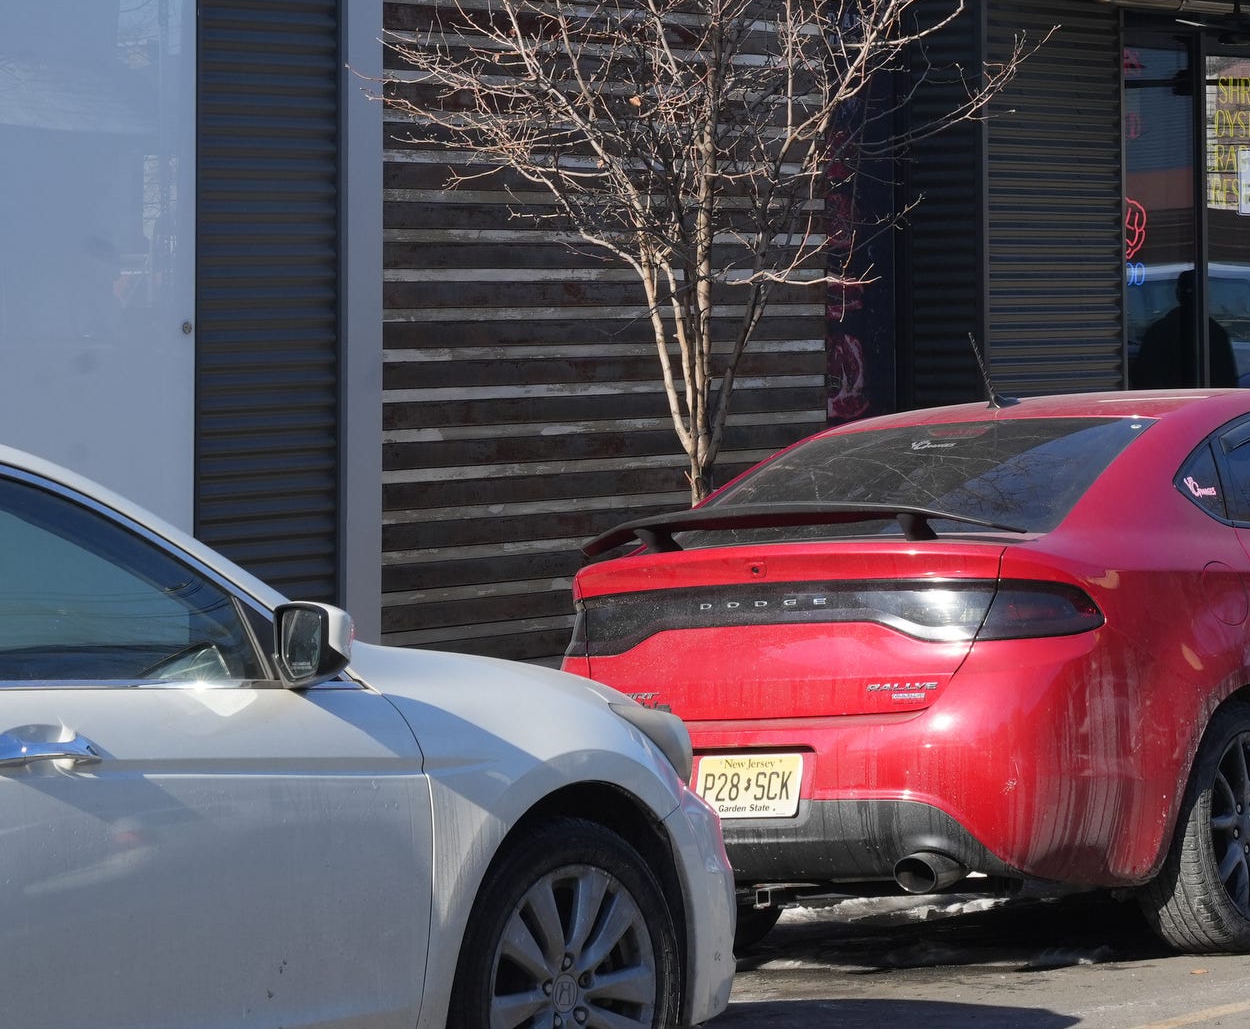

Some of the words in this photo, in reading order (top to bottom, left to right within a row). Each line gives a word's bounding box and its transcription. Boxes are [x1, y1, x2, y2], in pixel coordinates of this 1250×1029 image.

[700, 597, 827, 610] DODGE
[867, 681, 938, 691] RALLYE
[724, 759, 744, 769] New
[746, 758, 776, 770] Jersey
[718, 804, 747, 813] Garden
[749, 803, 770, 812] State
